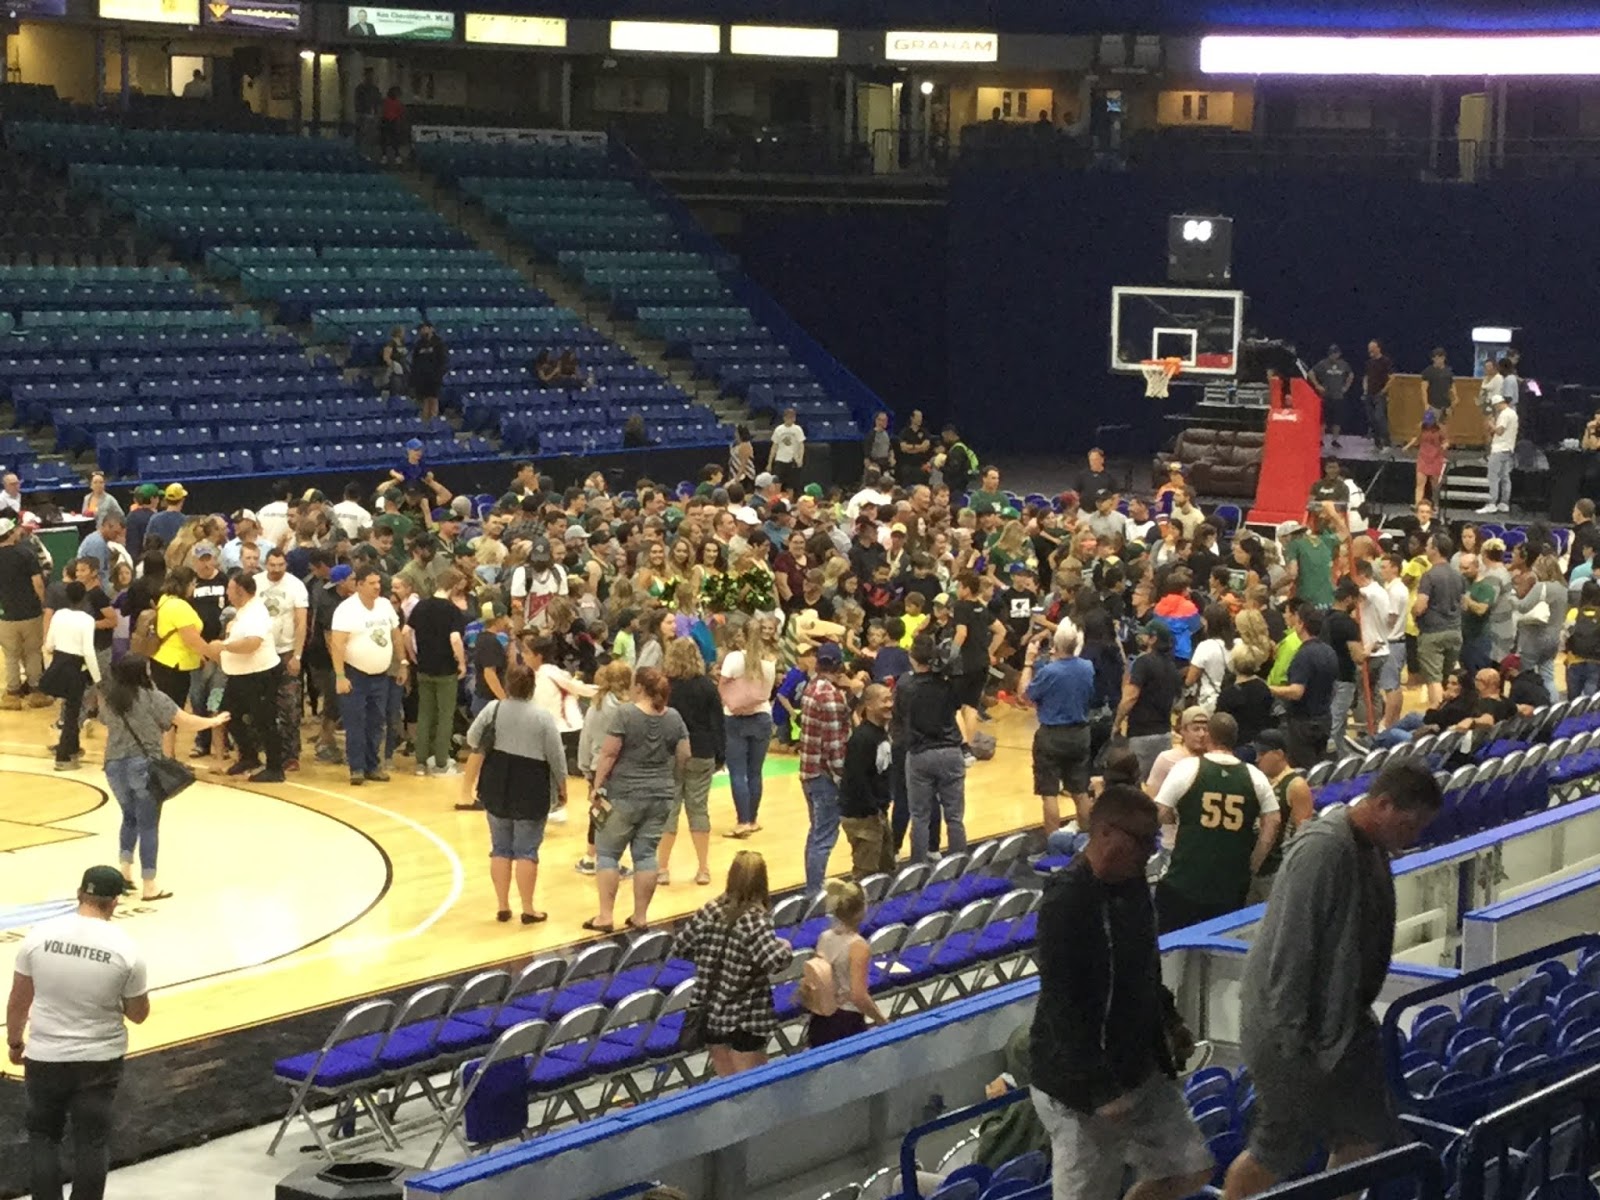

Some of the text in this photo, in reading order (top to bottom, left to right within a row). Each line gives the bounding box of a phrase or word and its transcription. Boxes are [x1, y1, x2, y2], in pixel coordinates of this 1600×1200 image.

[894, 38, 993, 52] GRAHAM
[1200, 791, 1245, 831] 55
[43, 939, 112, 964] VOLUNTEER
